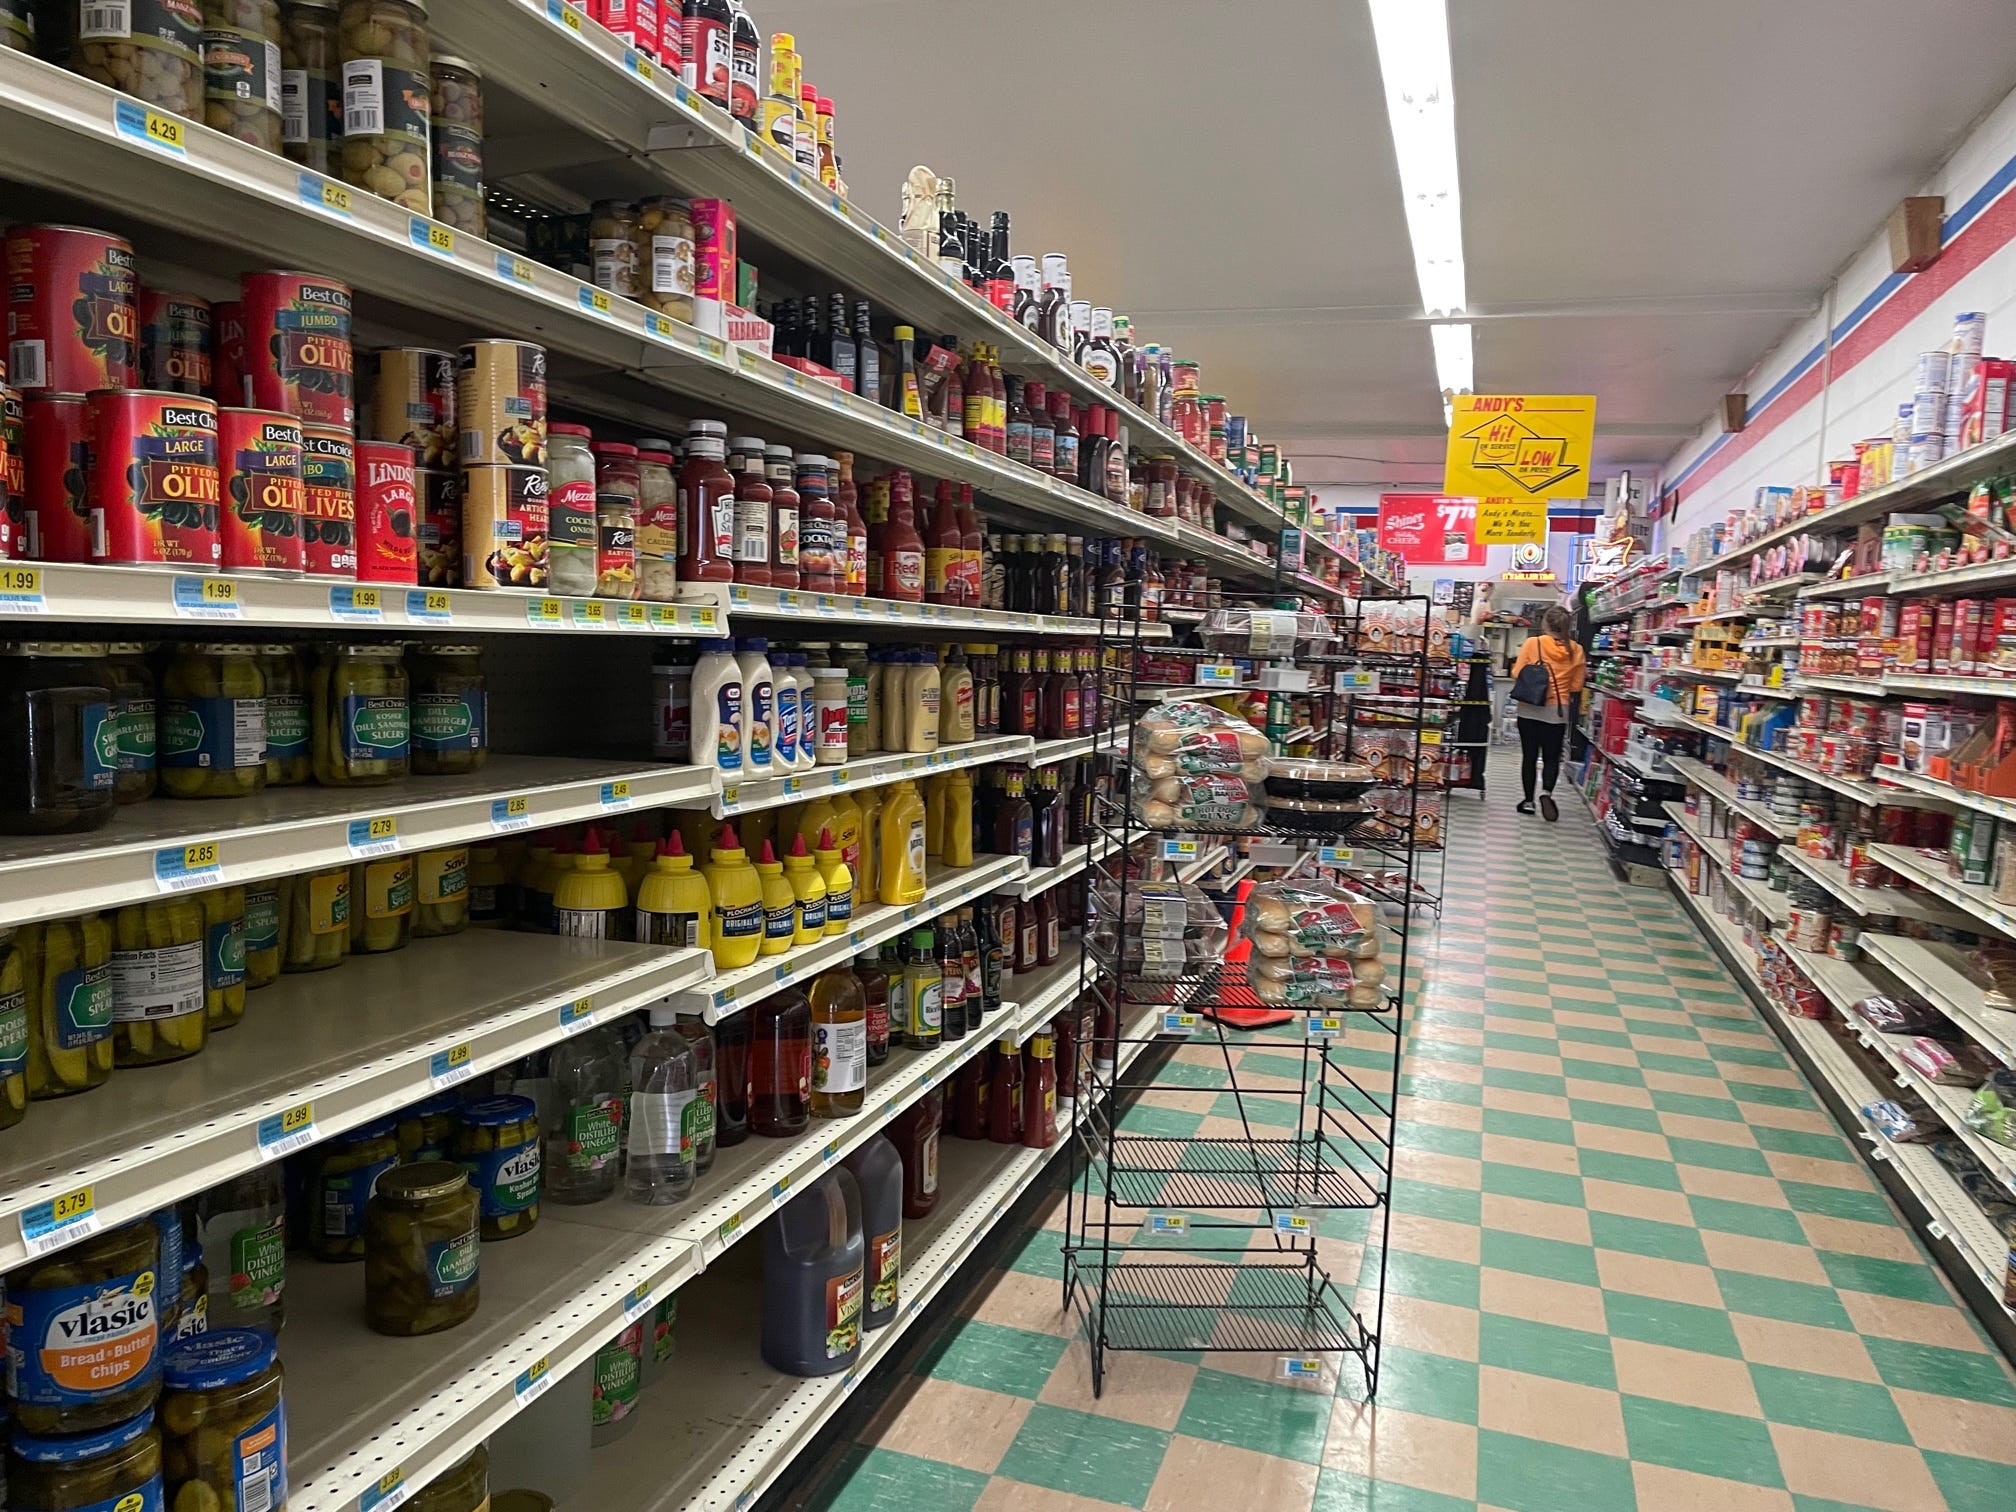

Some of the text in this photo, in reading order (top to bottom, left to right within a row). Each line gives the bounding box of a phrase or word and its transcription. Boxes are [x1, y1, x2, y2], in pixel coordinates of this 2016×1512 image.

[150, 119, 177, 141] 4.29
[325, 188, 347, 209] 5.45
[430, 227, 449, 248] 5.85
[109, 250, 130, 266] Best
[303, 287, 330, 302] Best
[301, 315, 338, 327] JUMBO
[1473, 398, 1525, 412] ANDY'S
[166, 410, 196, 426] Best
[266, 426, 291, 442] Best
[1489, 425, 1515, 442] Hi!
[165, 440, 204, 453] LARGE
[317, 440, 352, 457] Choice
[265, 454, 296, 467] LARGE
[1520, 450, 1556, 466] LOW
[171, 465, 211, 478] PITTED
[304, 496, 354, 520] LIVES
[1386, 537, 1421, 545] CHEER
[3, 572, 34, 589] 1.99
[208, 583, 231, 599] 1.99
[355, 592, 375, 606] 1.99
[429, 596, 446, 609] 2.49
[367, 699, 384, 709] Best
[356, 722, 375, 731] DILL
[372, 730, 404, 740] SLICERS
[510, 800, 525, 812] 2.85
[1216, 805, 1239, 815] DOG
[1200, 812, 1233, 821] BUNS
[373, 820, 391, 835] 2.79
[189, 847, 213, 863] 2.85
[726, 919, 753, 928] ORIGINAL
[139, 950, 156, 960] Facts
[86, 971, 100, 983] Best
[575, 1000, 589, 1013] 2.45
[450, 1048, 467, 1062] 2.99
[286, 1108, 307, 1126] 2.99
[579, 1125, 617, 1141] DISTILLED
[587, 1121, 611, 1132] White
[581, 1135, 616, 1150] VINEGAR
[509, 1180, 532, 1194] Kosher
[58, 1192, 86, 1214] 3.79
[61, 1349, 105, 1368] Bread
[114, 1334, 152, 1356] Butter
[90, 1360, 130, 1380] Chips
[531, 1358, 546, 1377] 2.65
[610, 1358, 633, 1372] White
[600, 1363, 636, 1384] DISTILLED
[601, 1373, 635, 1393] VINEGAR
